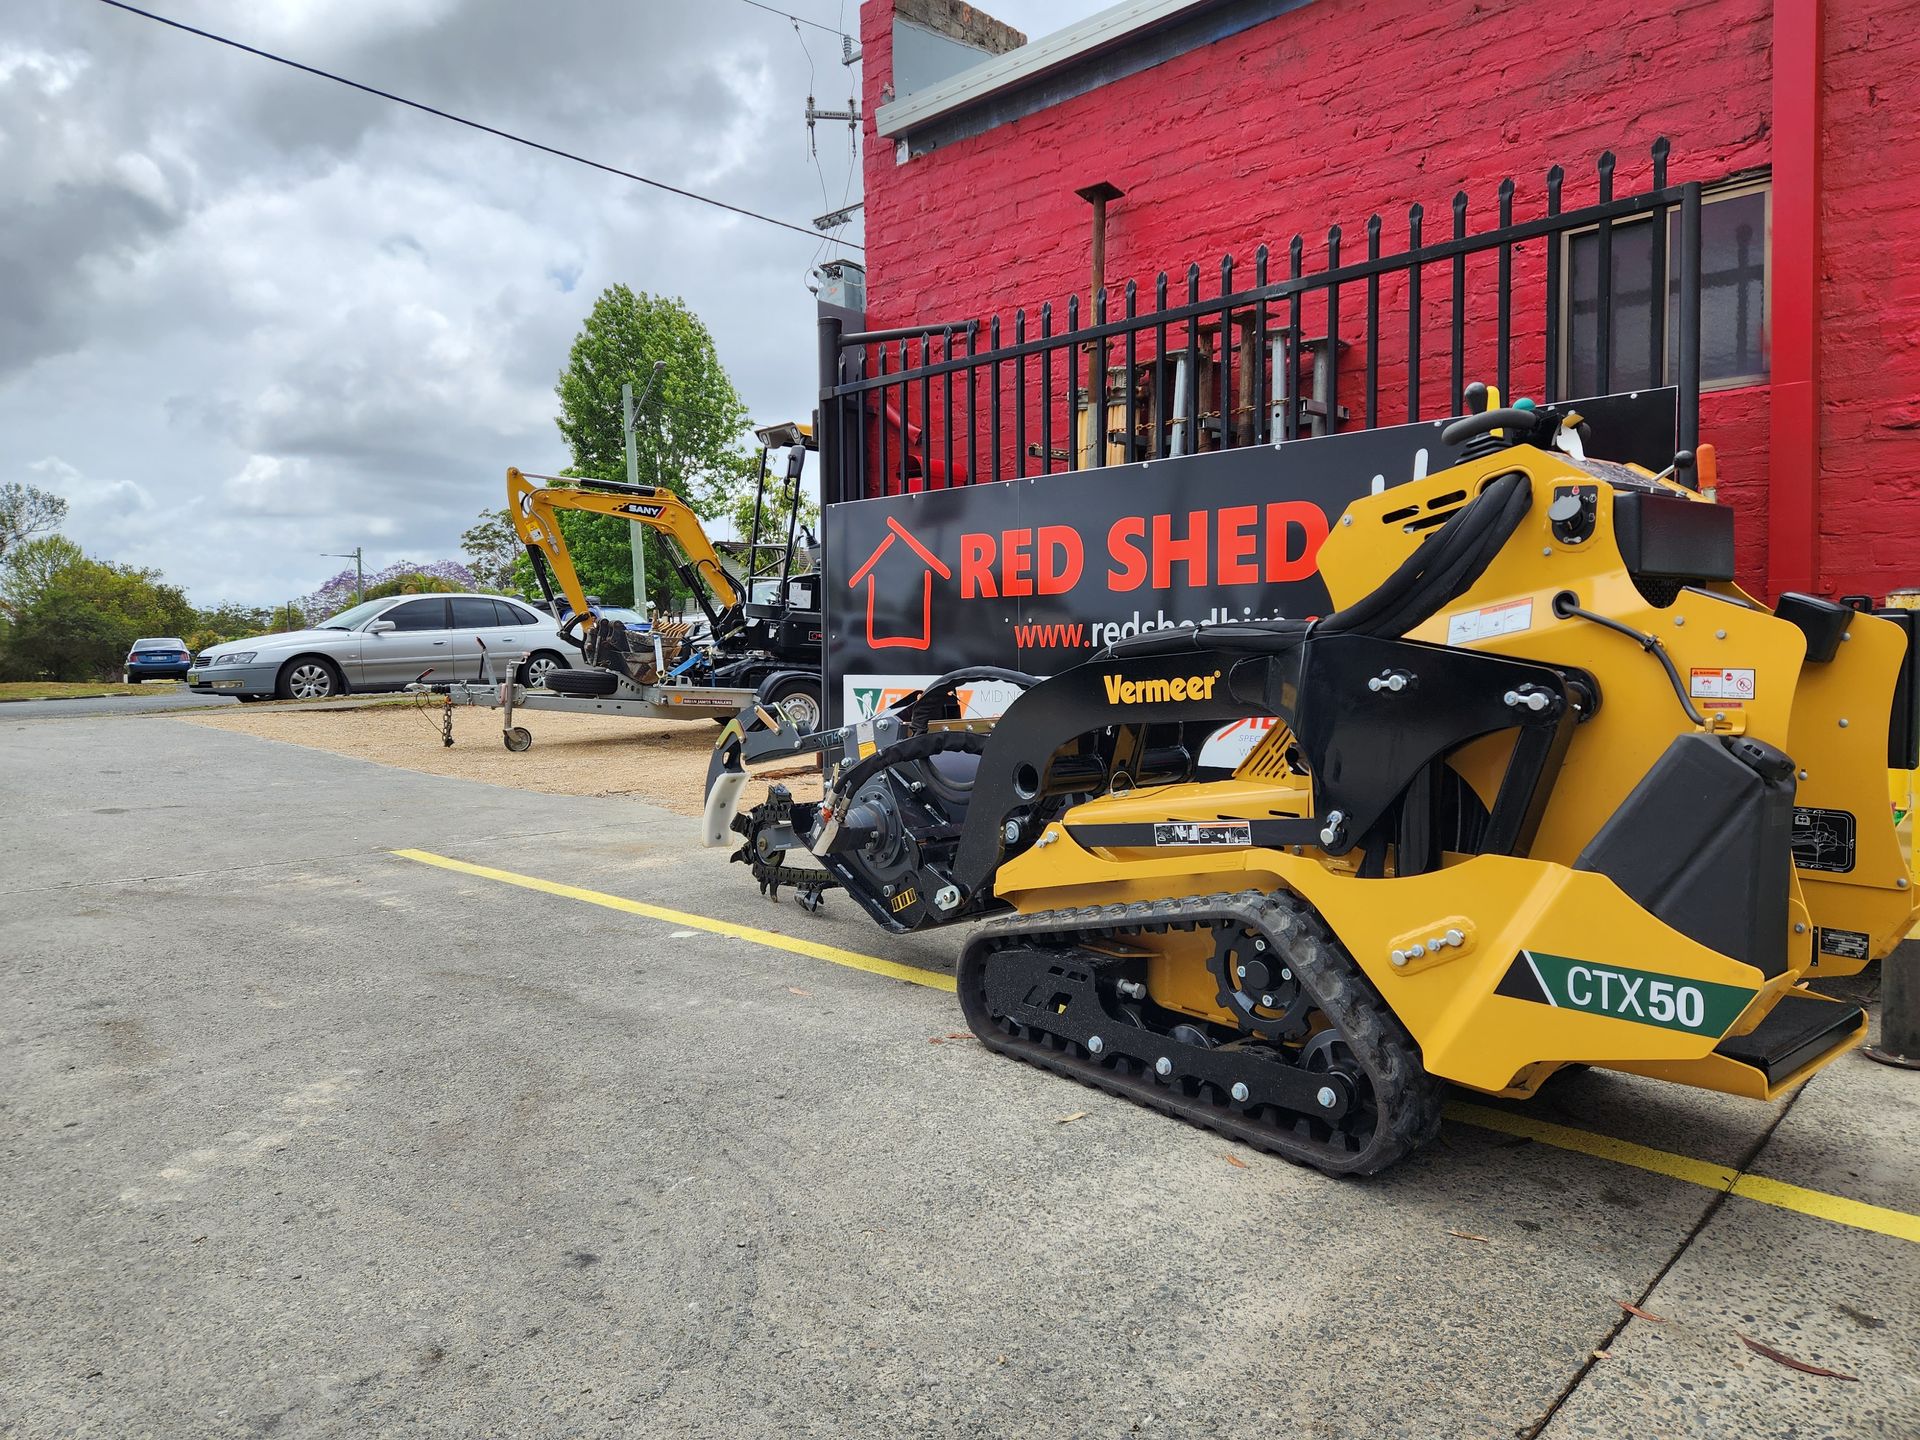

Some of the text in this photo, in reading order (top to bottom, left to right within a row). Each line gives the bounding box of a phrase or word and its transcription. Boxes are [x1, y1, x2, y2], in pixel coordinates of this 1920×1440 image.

[628, 504, 659, 515] SANY
[960, 500, 1330, 599] RED SHED
[980, 689, 1003, 703] MID
[1103, 674, 1215, 705] Vermeer
[1567, 966, 1705, 1028] CTX50
